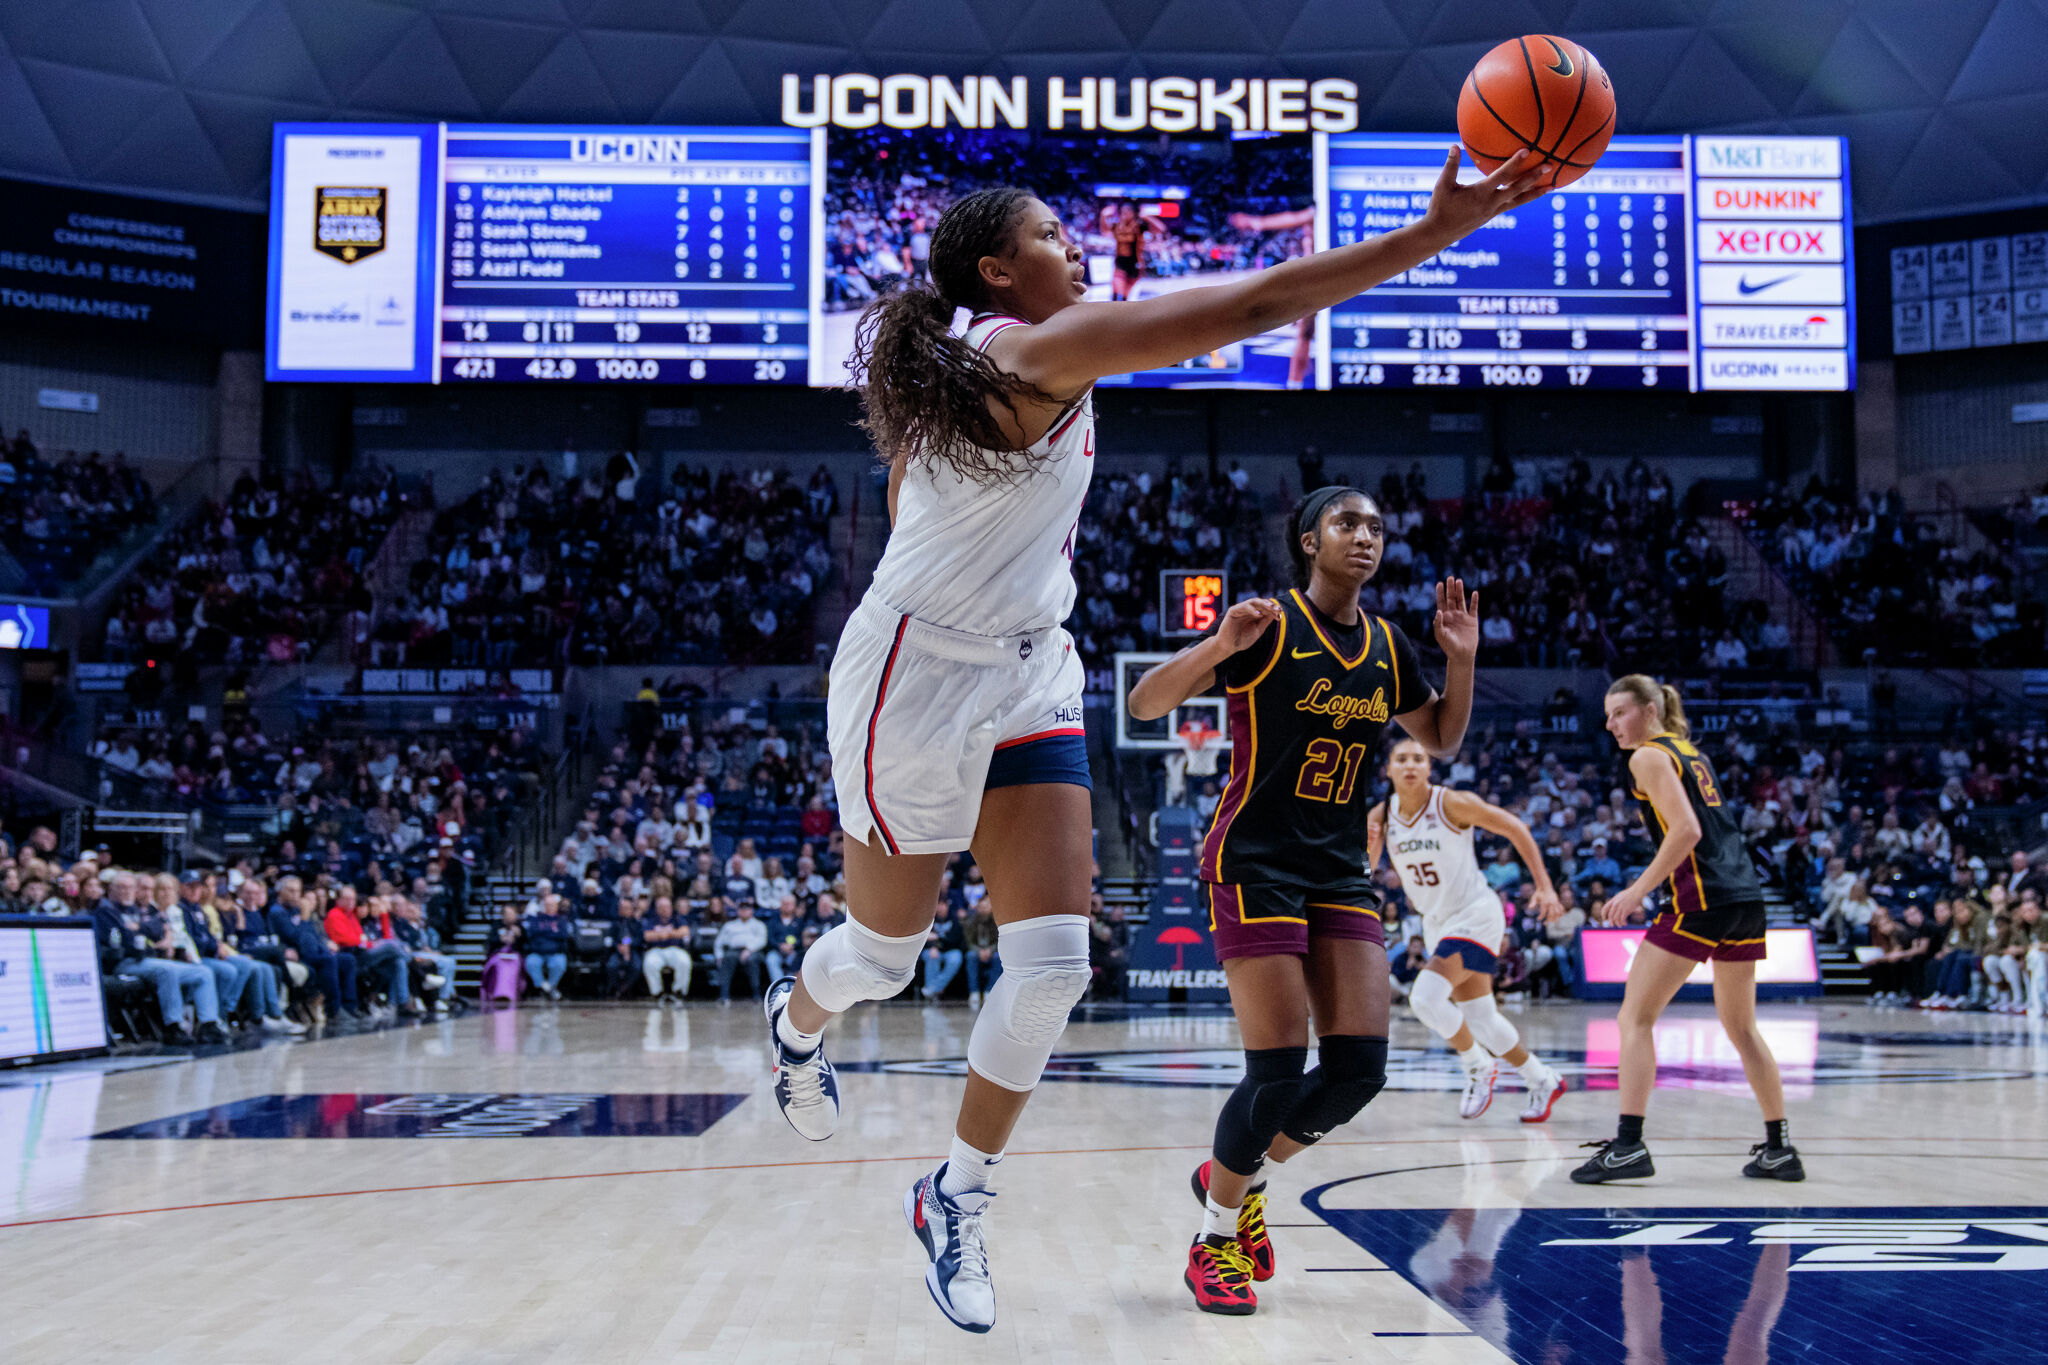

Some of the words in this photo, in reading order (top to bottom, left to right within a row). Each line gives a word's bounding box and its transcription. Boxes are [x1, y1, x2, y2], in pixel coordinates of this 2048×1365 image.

[782, 73, 1028, 128] UCONN
[1047, 77, 1359, 132] HUSKIES
[570, 136, 689, 163] UCONN
[1709, 147, 1763, 167] M&T
[1771, 147, 1827, 167] Bank
[458, 185, 471, 200] 9
[482, 187, 554, 203] Kayleigh
[556, 188, 612, 202] Heckel
[678, 188, 688, 203] 2
[714, 188, 721, 202] 1
[746, 189, 757, 203] 2
[780, 189, 793, 203] 0
[1339, 193, 1353, 209] 2
[1363, 192, 1408, 209] Alexa
[1552, 195, 1565, 211] 0
[1588, 195, 1596, 210] 1
[1619, 195, 1632, 212] 2
[1653, 195, 1666, 213] 2
[455, 204, 473, 223] 12
[482, 205, 547, 224] Ashlynn
[550, 205, 601, 220] Shade
[676, 207, 688, 221] 4
[709, 206, 723, 221] 0
[748, 207, 756, 221] 1
[779, 207, 793, 222] 0
[1338, 212, 1356, 227] 10
[1585, 214, 1599, 229] 0
[1619, 214, 1633, 230] 0
[1653, 214, 1667, 230] 0
[68, 212, 185, 241] CONFERENCE
[454, 222, 473, 242] 21
[481, 223, 528, 239] Sarah
[530, 223, 588, 242] Strong
[677, 225, 688, 240] 7
[710, 226, 722, 240] 4
[748, 226, 756, 240] 1
[779, 226, 793, 241] 0
[1554, 232, 1565, 248] 2
[1588, 232, 1597, 248] 1
[1623, 233, 1631, 248] 1
[1656, 233, 1665, 248] 1
[1716, 230, 1825, 253] xerox
[452, 241, 474, 261] 22
[481, 242, 528, 257] Sarah
[531, 243, 601, 258] Williams
[709, 244, 723, 259] 0
[745, 245, 757, 259] 4
[782, 245, 790, 259] 1
[1439, 249, 1500, 268] Vaughn
[1554, 250, 1565, 266] 2
[1586, 251, 1600, 267] 0
[1623, 251, 1632, 266] 1
[1654, 251, 1668, 267] 0
[0, 250, 103, 279] REGULAR
[109, 264, 196, 290] SEASON
[452, 260, 474, 276] 35
[480, 261, 518, 276] Azzi
[520, 261, 564, 277] Fudd
[710, 262, 722, 278] 2
[745, 263, 756, 278] 2
[782, 264, 790, 278] 1
[1554, 269, 1566, 285] 2
[1589, 269, 1598, 285] 1
[1621, 270, 1634, 285] 4
[1654, 270, 1669, 286] 0
[0, 286, 151, 321] TOURNAMENT
[576, 289, 626, 307] TEAM
[627, 290, 680, 308] STATS
[1457, 296, 1507, 314] TEAM
[1508, 297, 1560, 315] STATS
[462, 322, 488, 341] 14
[523, 322, 539, 342] 8
[554, 322, 573, 341] 11
[614, 322, 641, 342] 19
[686, 323, 711, 343] 12
[764, 324, 778, 343] 3
[1355, 328, 1368, 348] 3
[1408, 329, 1424, 348] 2
[1436, 329, 1462, 349] 10
[1497, 330, 1522, 349] 12
[1571, 331, 1587, 350] 5
[1641, 331, 1657, 351] 2
[1715, 323, 1811, 340] TRAVELERS
[453, 358, 495, 378] 47.1
[526, 358, 576, 379] 42.9
[596, 358, 660, 380] 100.0
[690, 359, 706, 379] 8
[753, 360, 787, 381] 20
[1339, 365, 1385, 385] 27.8
[1412, 365, 1461, 386] 22.2
[1481, 365, 1543, 386] 100.0
[1567, 366, 1592, 386] 17
[1642, 366, 1658, 387] 3
[1711, 363, 1778, 377] UCONN
[1184, 595, 1216, 630] 15
[1296, 678, 1389, 730] Loyola
[1055, 707, 1083, 722] HUS
[1295, 737, 1366, 804] 21
[1690, 761, 1722, 806] 2
[1407, 862, 1440, 887] 35
[1127, 969, 1228, 989] TRAVELERS
